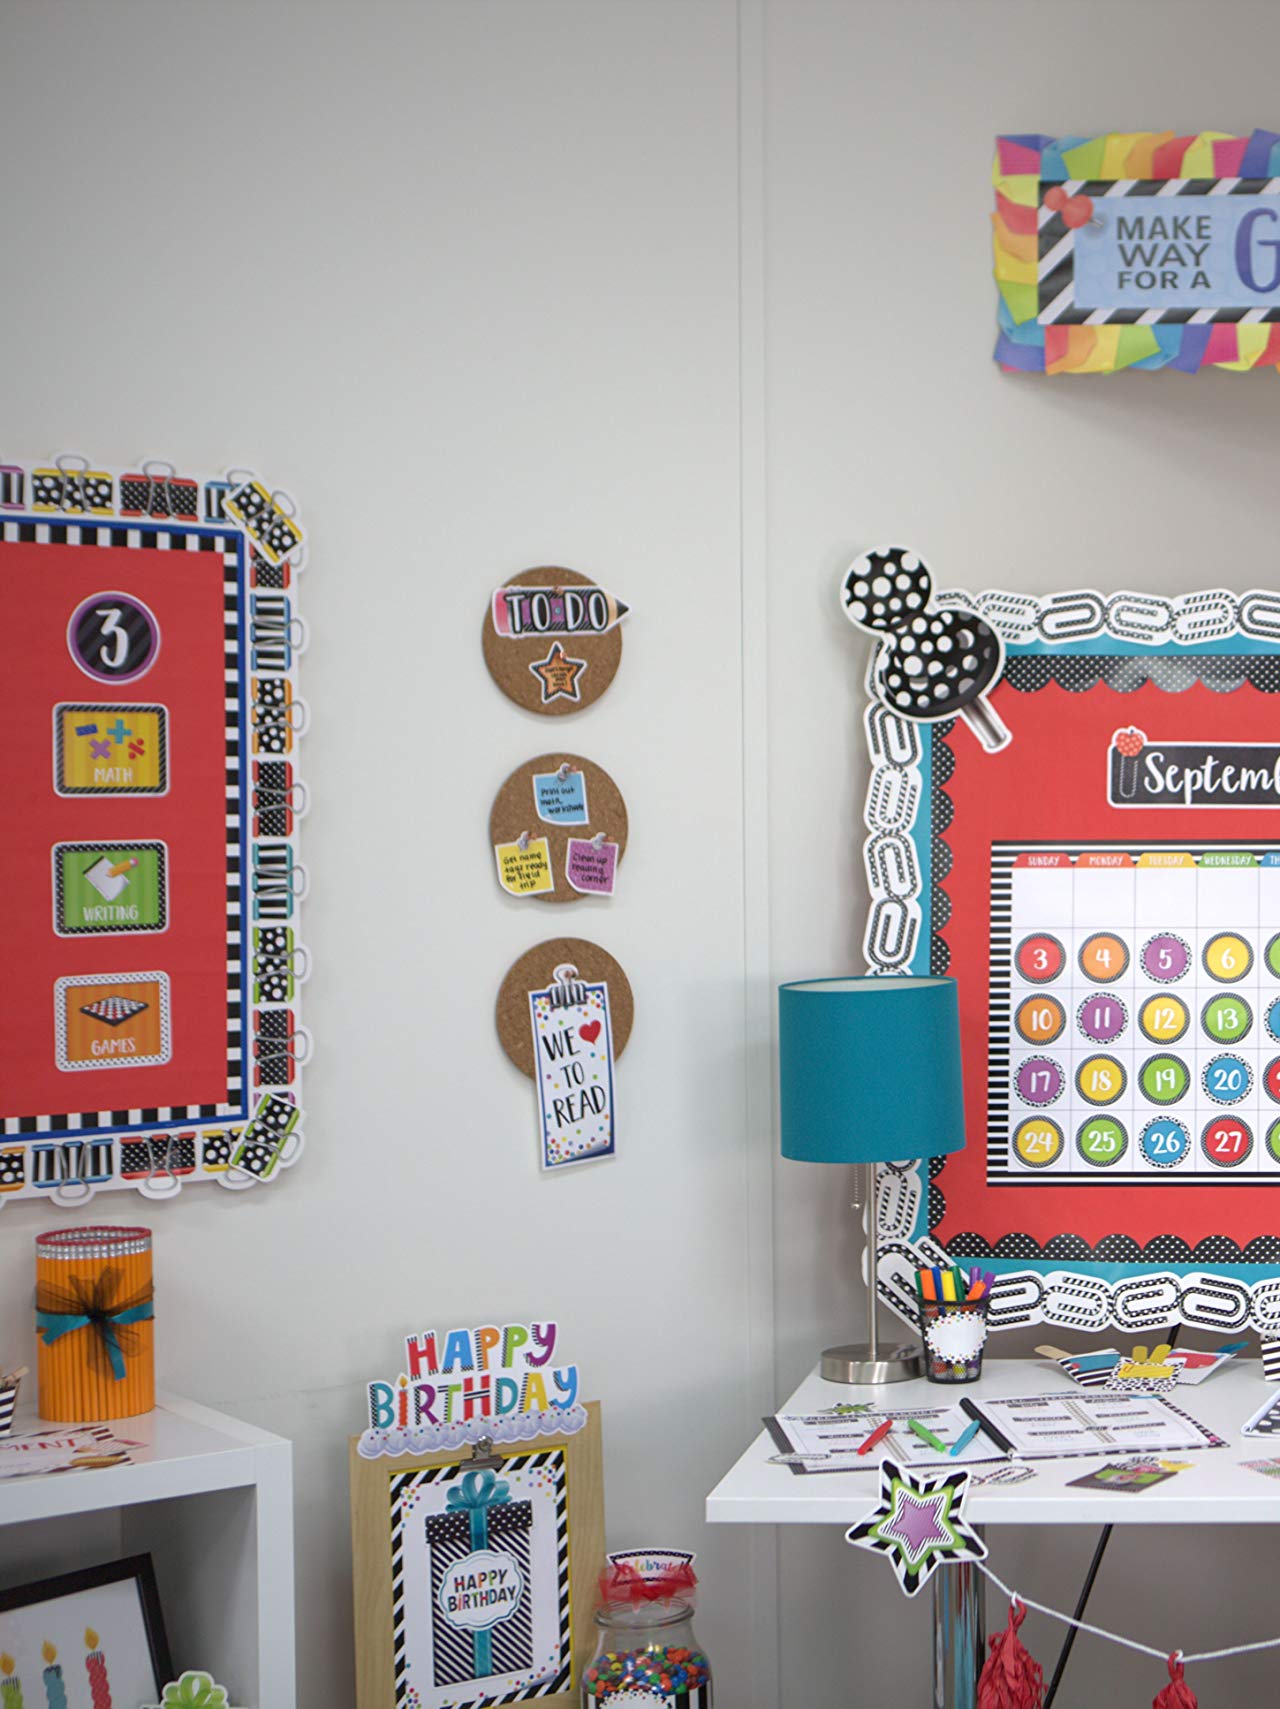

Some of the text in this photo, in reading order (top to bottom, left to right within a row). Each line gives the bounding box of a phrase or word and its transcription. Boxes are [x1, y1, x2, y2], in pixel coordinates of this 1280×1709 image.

[1116, 214, 1212, 240] MAKE
[1117, 243, 1211, 268] WAY
[1117, 270, 1212, 290] FOR A
[505, 591, 609, 632] TO DO
[96, 608, 129, 667] 3
[94, 766, 134, 784] MATH
[1028, 856, 1060, 867] SUNDAY
[1089, 856, 1124, 867] MONDAY
[1204, 855, 1252, 866] WEDNESDAY
[83, 904, 140, 922] WRITING
[1033, 948, 1048, 970] 3
[1095, 948, 1112, 969] 4
[1158, 948, 1174, 970] 5
[1220, 947, 1236, 969] 6
[1032, 1008, 1053, 1031] 10
[1094, 1007, 1111, 1029] 11
[1153, 1008, 1178, 1030] 12
[1217, 1008, 1239, 1031] 13
[92, 1036, 137, 1056] GAMES
[542, 1026, 581, 1062] WE
[560, 1062, 585, 1089] TO
[1031, 1070, 1051, 1094] 17
[1091, 1069, 1112, 1092] 18
[1156, 1068, 1176, 1092] 19
[1213, 1069, 1242, 1091] 20
[553, 1085, 607, 1129] READ
[1024, 1131, 1054, 1154] 24
[1088, 1130, 1117, 1153] 25
[1150, 1130, 1180, 1155] 26
[1214, 1130, 1243, 1153] 27
[406, 1323, 557, 1382] HAPPY
[369, 1365, 578, 1430] BIRTHDAY
[453, 1568, 509, 1594] HAPPY
[447, 1585, 517, 1615] BIRTHDAY
